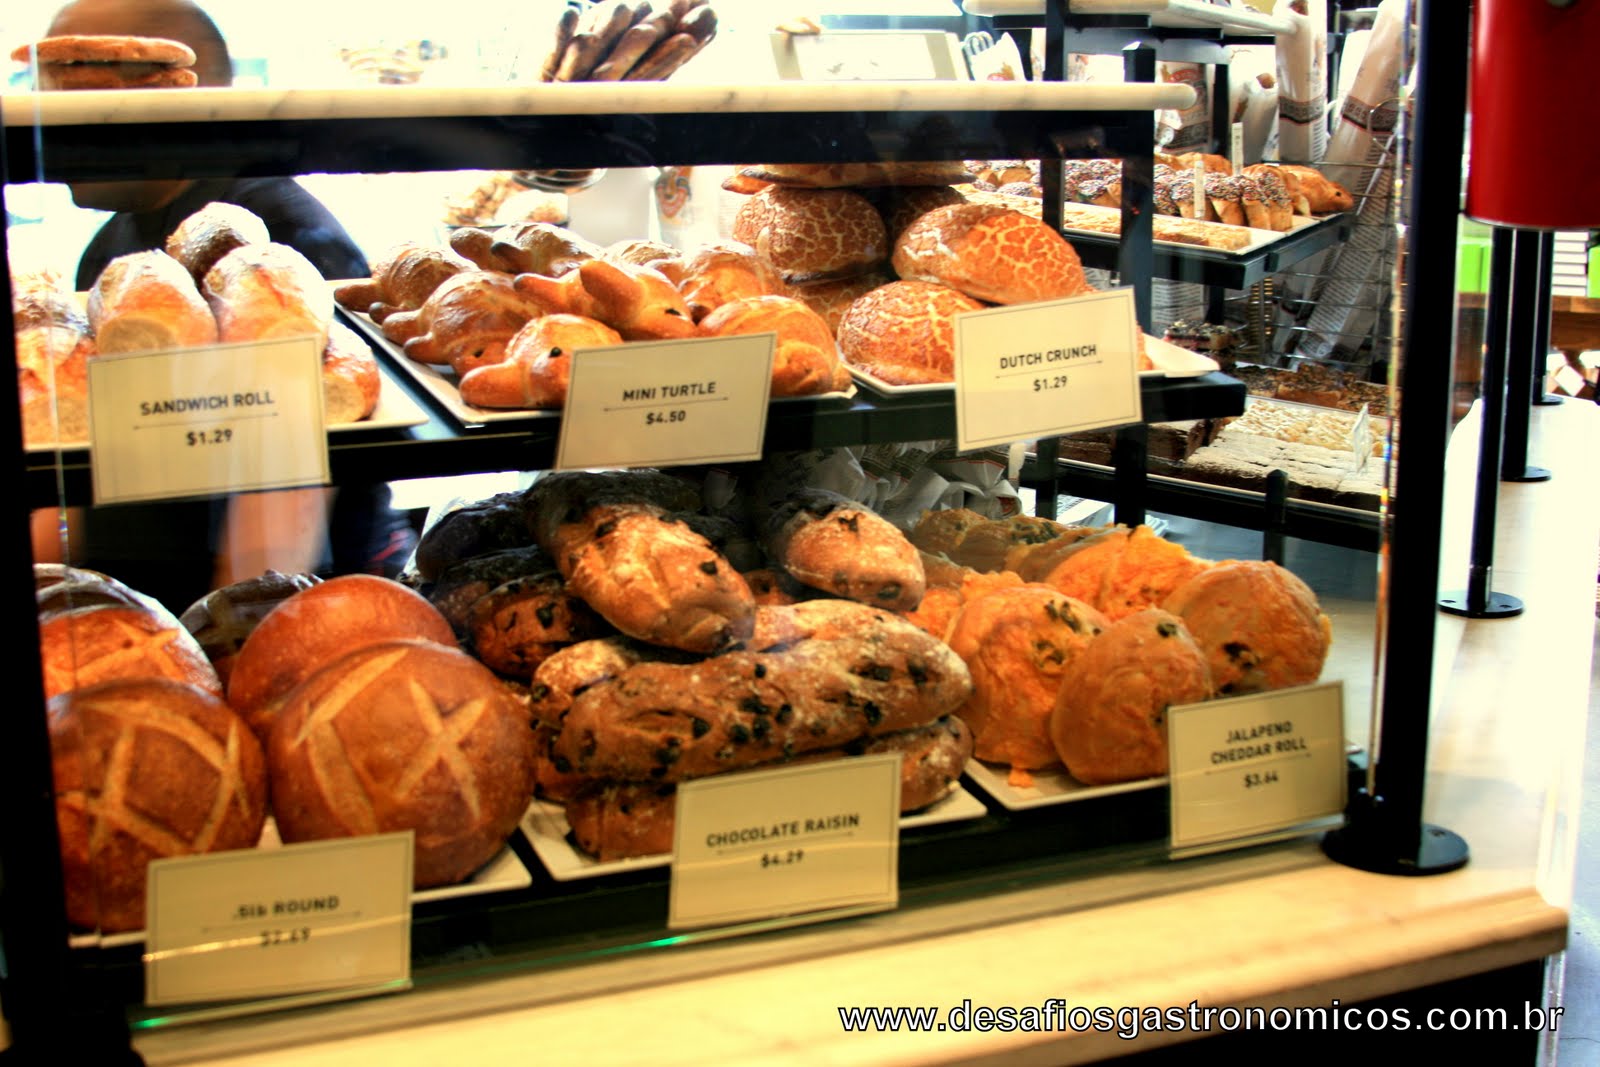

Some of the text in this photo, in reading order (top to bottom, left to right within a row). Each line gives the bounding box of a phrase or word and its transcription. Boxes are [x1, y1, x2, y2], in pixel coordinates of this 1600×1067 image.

[1000, 344, 1097, 369] DUTCH CRUNCH
[622, 381, 716, 401] MINI TURTLE
[1033, 375, 1068, 392] $1.29
[140, 391, 275, 416] SANDWICH ROLL
[646, 410, 686, 425] $4.50
[186, 429, 233, 446] $1.29
[1211, 736, 1307, 764] CHEDDAR ROLL
[706, 813, 860, 847] CHOCOLATE RAISIN
[761, 850, 804, 868] $4.29
[273, 896, 340, 914] ROUND
